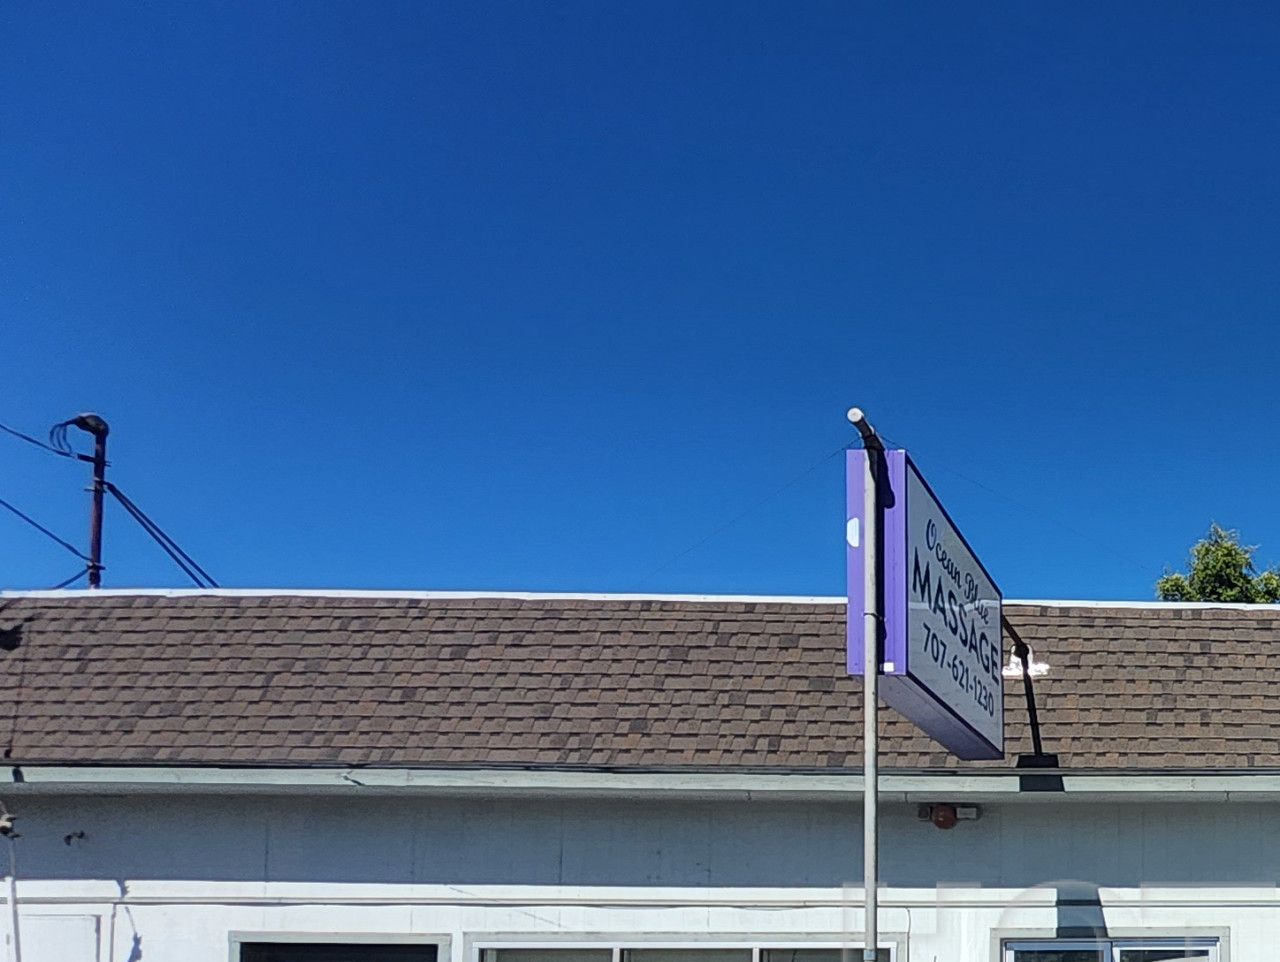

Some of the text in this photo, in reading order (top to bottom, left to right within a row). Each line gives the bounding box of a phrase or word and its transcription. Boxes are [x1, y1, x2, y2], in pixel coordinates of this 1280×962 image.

[912, 546, 1000, 686] MASSAGE
[926, 518, 989, 625] Ocean Blue
[923, 621, 994, 718] 707-621-1230
